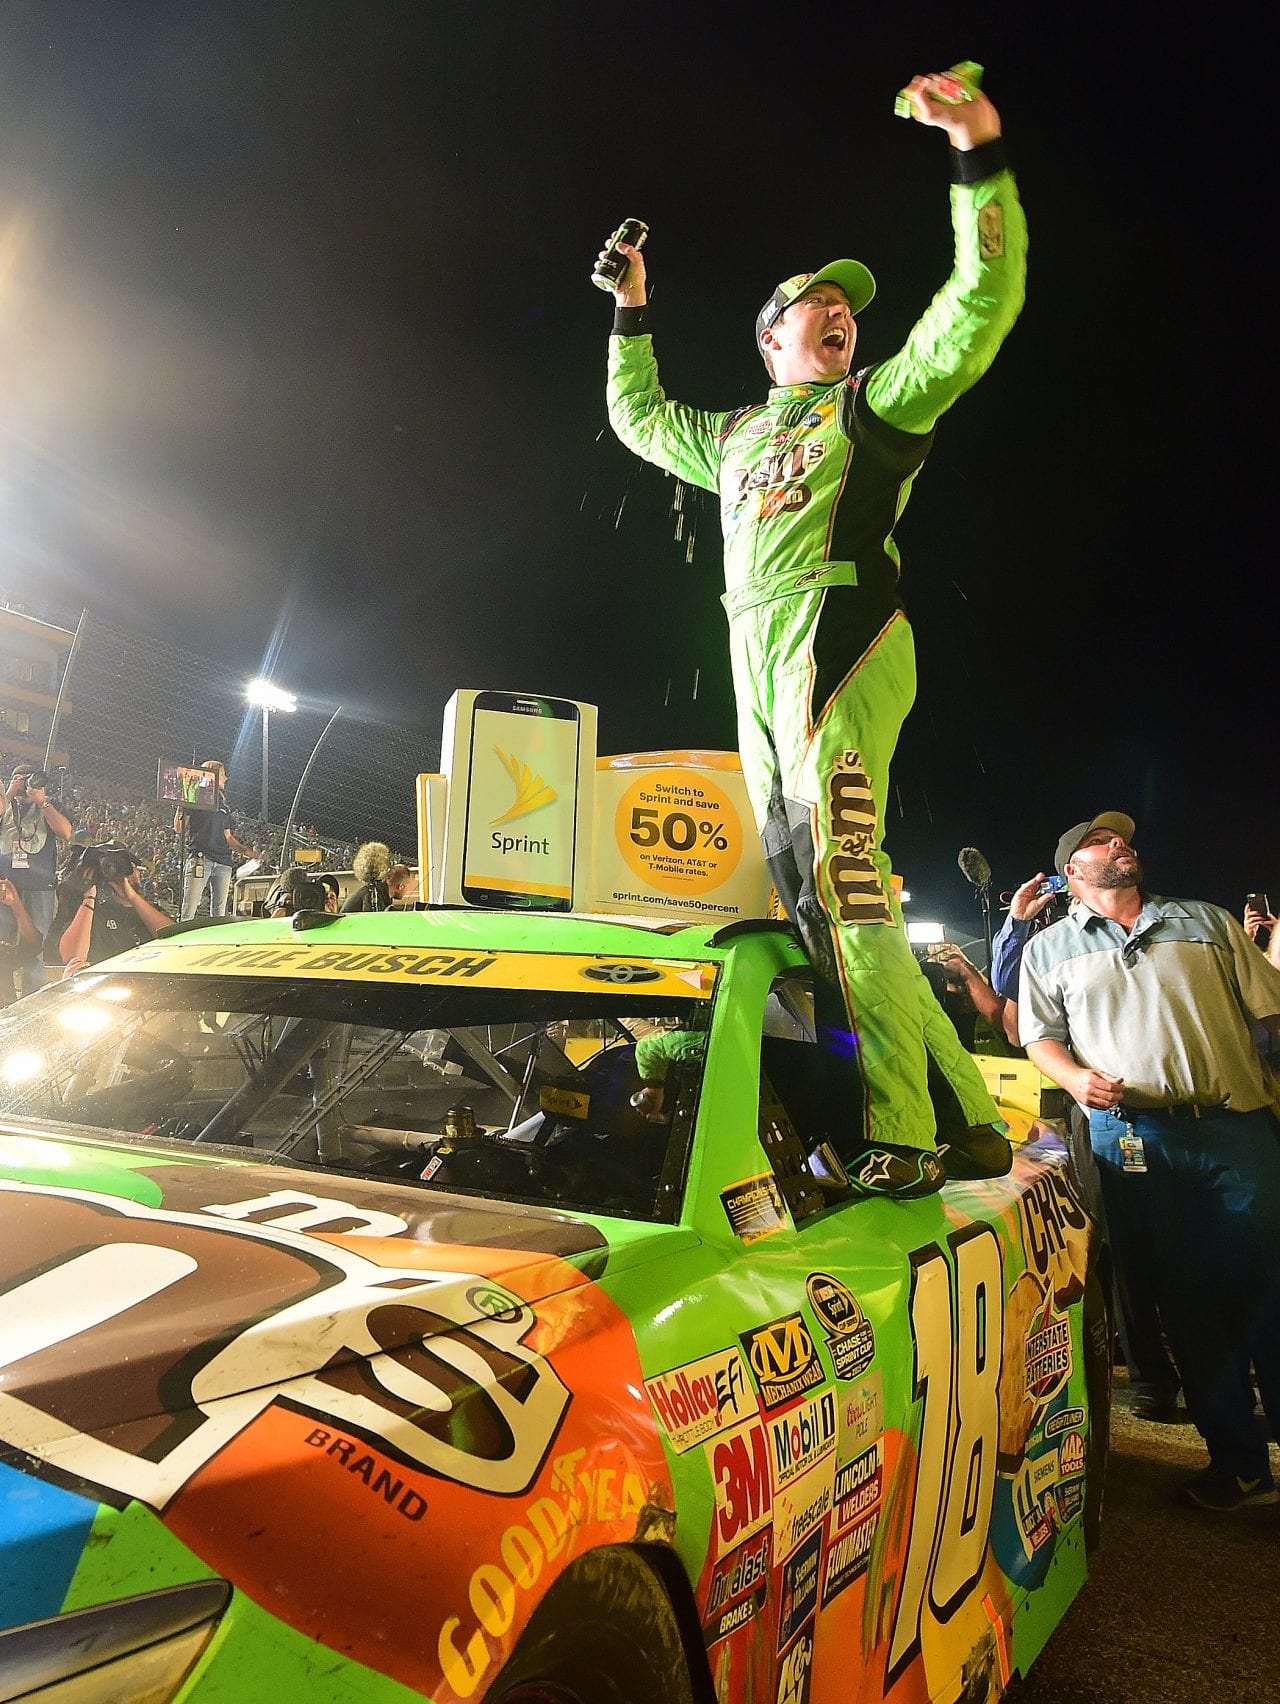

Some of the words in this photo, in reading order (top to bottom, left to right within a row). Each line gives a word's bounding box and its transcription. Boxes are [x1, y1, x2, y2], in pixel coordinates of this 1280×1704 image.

[512, 705, 543, 714] SAMSUNG
[639, 792, 672, 804] Sprint
[673, 797, 694, 807] and
[695, 800, 720, 810] save
[655, 783, 691, 796] Switch
[693, 788, 705, 798] to
[491, 831, 551, 856] Sprint
[630, 807, 728, 851] 50%
[639, 853, 651, 861] on
[652, 854, 685, 866] Verizon,
[686, 858, 707, 868] AT&T
[648, 862, 684, 873] T-Mobile
[685, 867, 709, 877] rates.
[613, 892, 739, 913] sprint.com/save50percent
[187, 950, 311, 968] KYLE
[296, 952, 497, 977] BUSCH
[1021, 1169, 1086, 1275] CRIS
[752, 1316, 810, 1384] M
[836, 1333, 861, 1356] CHASE
[836, 1350, 860, 1369] SPRINT
[859, 1341, 873, 1356] CUP
[1025, 1322, 1068, 1358] INTERSTATE
[760, 1376, 803, 1407] MECHANIX
[802, 1359, 823, 1388] WEAR
[1026, 1347, 1069, 1391] BATTERIES
[648, 1372, 723, 1432] Holley
[715, 1356, 745, 1414] EFI
[774, 1402, 820, 1473] Mobil
[820, 1392, 835, 1441] 1
[304, 1428, 429, 1522] BRAND
[835, 1450, 876, 1501] LINCOLN
[884, 1221, 1004, 1698] 18
[1061, 1458, 1084, 1475] TOOLS
[714, 1424, 770, 1543] 3M
[842, 1478, 879, 1523] WELDERS
[790, 1485, 831, 1546] freescale
